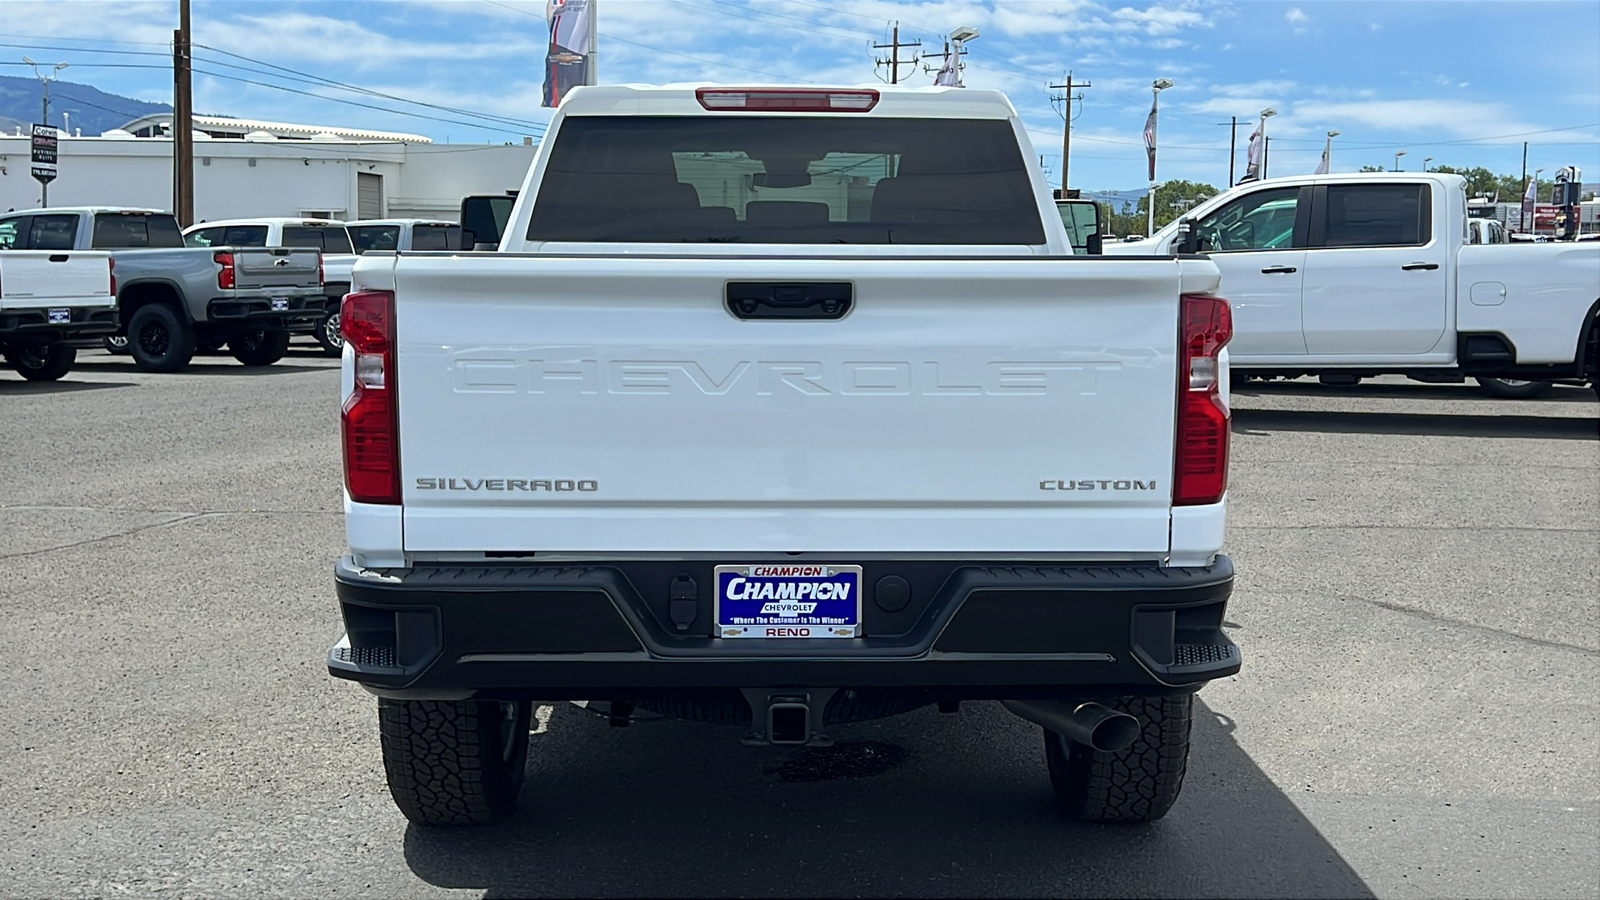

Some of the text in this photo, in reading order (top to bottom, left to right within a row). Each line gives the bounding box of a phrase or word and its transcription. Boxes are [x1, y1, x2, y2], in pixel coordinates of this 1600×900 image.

[452, 358, 1123, 397] CHEVROLET
[415, 477, 599, 492] SILVERADO
[1039, 480, 1157, 491] CUSTOM
[754, 566, 822, 576] CHAMPION
[726, 577, 851, 601] CHAMPION
[764, 604, 813, 612] CHEVROLET
[756, 616, 769, 625] The
[769, 616, 800, 625] Customer
[801, 616, 808, 625] Is
[808, 616, 821, 625] The
[766, 627, 810, 637] RENO
